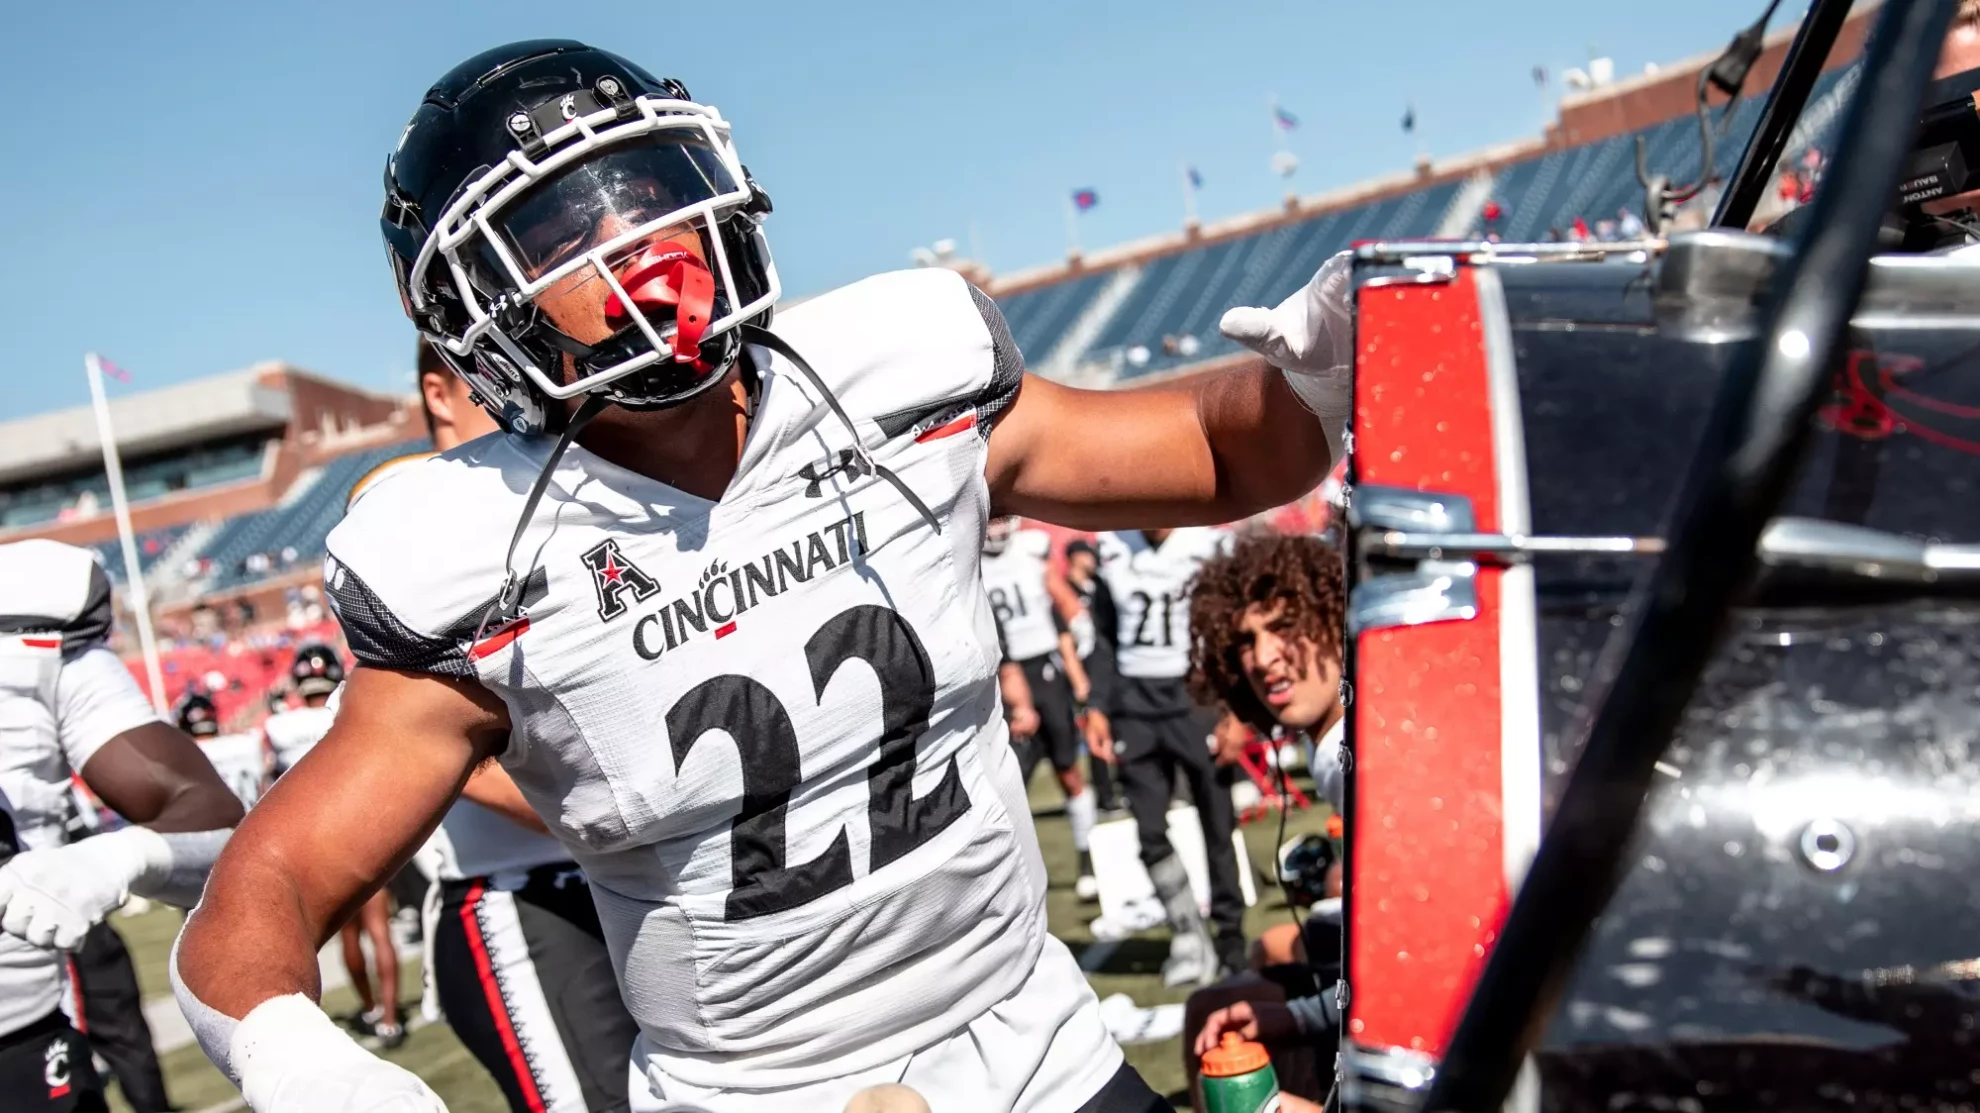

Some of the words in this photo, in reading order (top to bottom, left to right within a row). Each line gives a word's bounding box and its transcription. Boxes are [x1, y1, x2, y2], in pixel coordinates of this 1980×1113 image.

[580, 538, 661, 623] A
[632, 510, 870, 660] CINCINNATI
[988, 583, 1026, 621] 81
[1130, 590, 1172, 646] 21
[665, 604, 972, 921] 22
